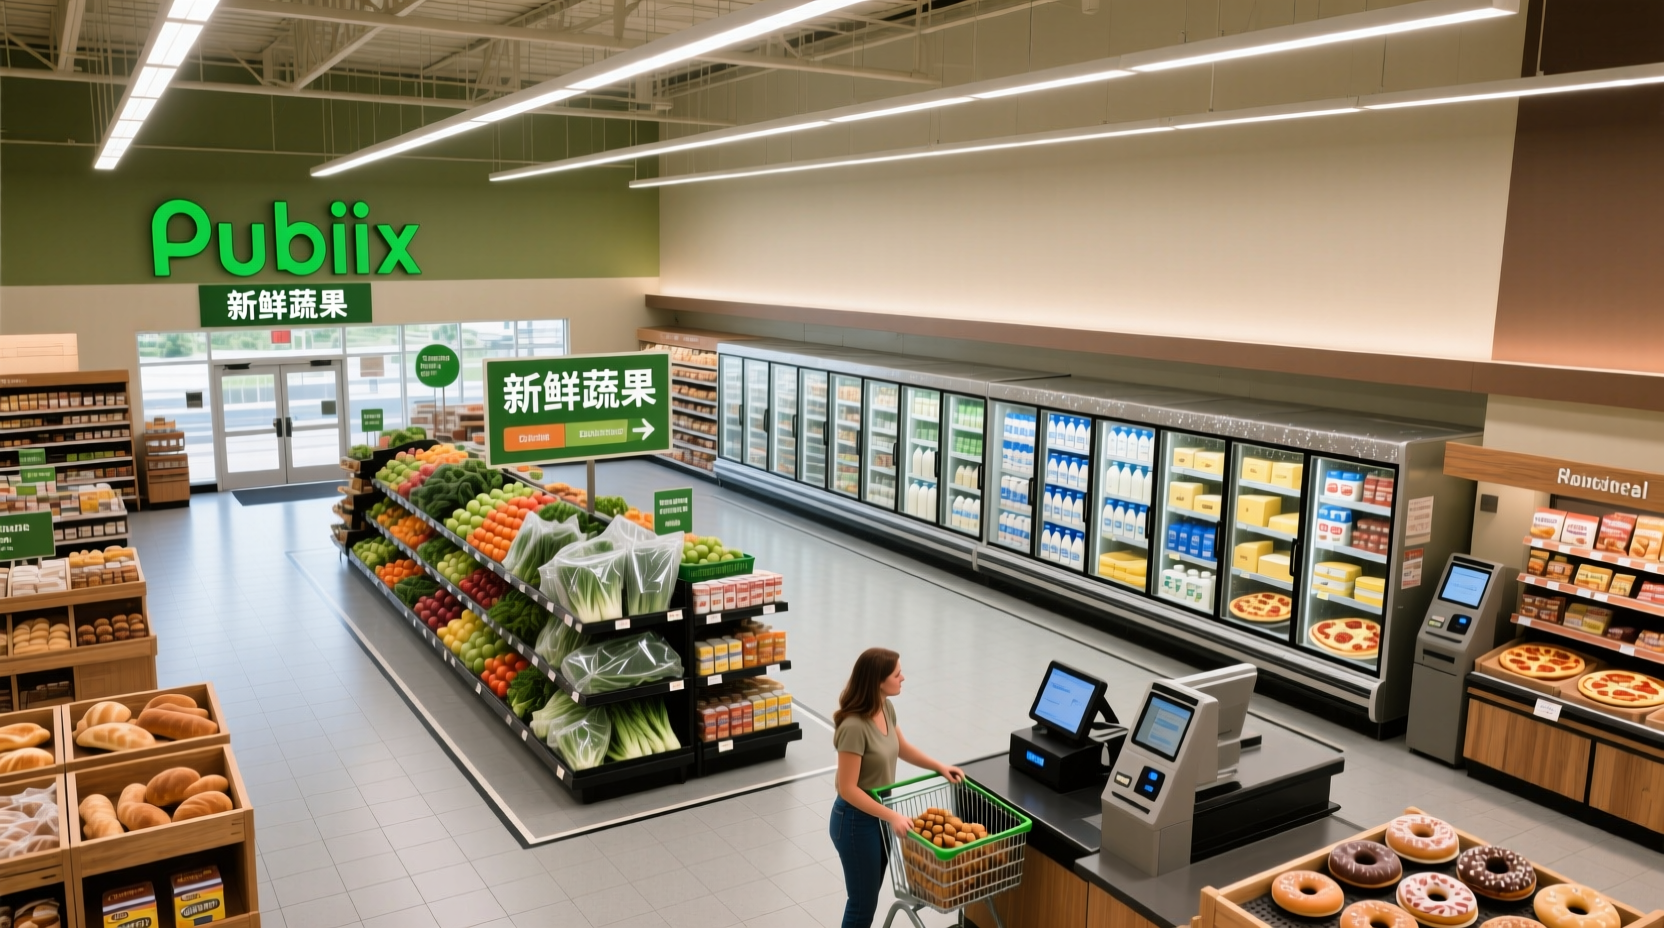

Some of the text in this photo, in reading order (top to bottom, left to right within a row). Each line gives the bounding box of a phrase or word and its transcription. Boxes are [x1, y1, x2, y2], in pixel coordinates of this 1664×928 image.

[151, 199, 422, 277] Pubiix
[227, 289, 348, 320] 新鲜蔬果
[503, 369, 657, 414] 新鲜蔬果
